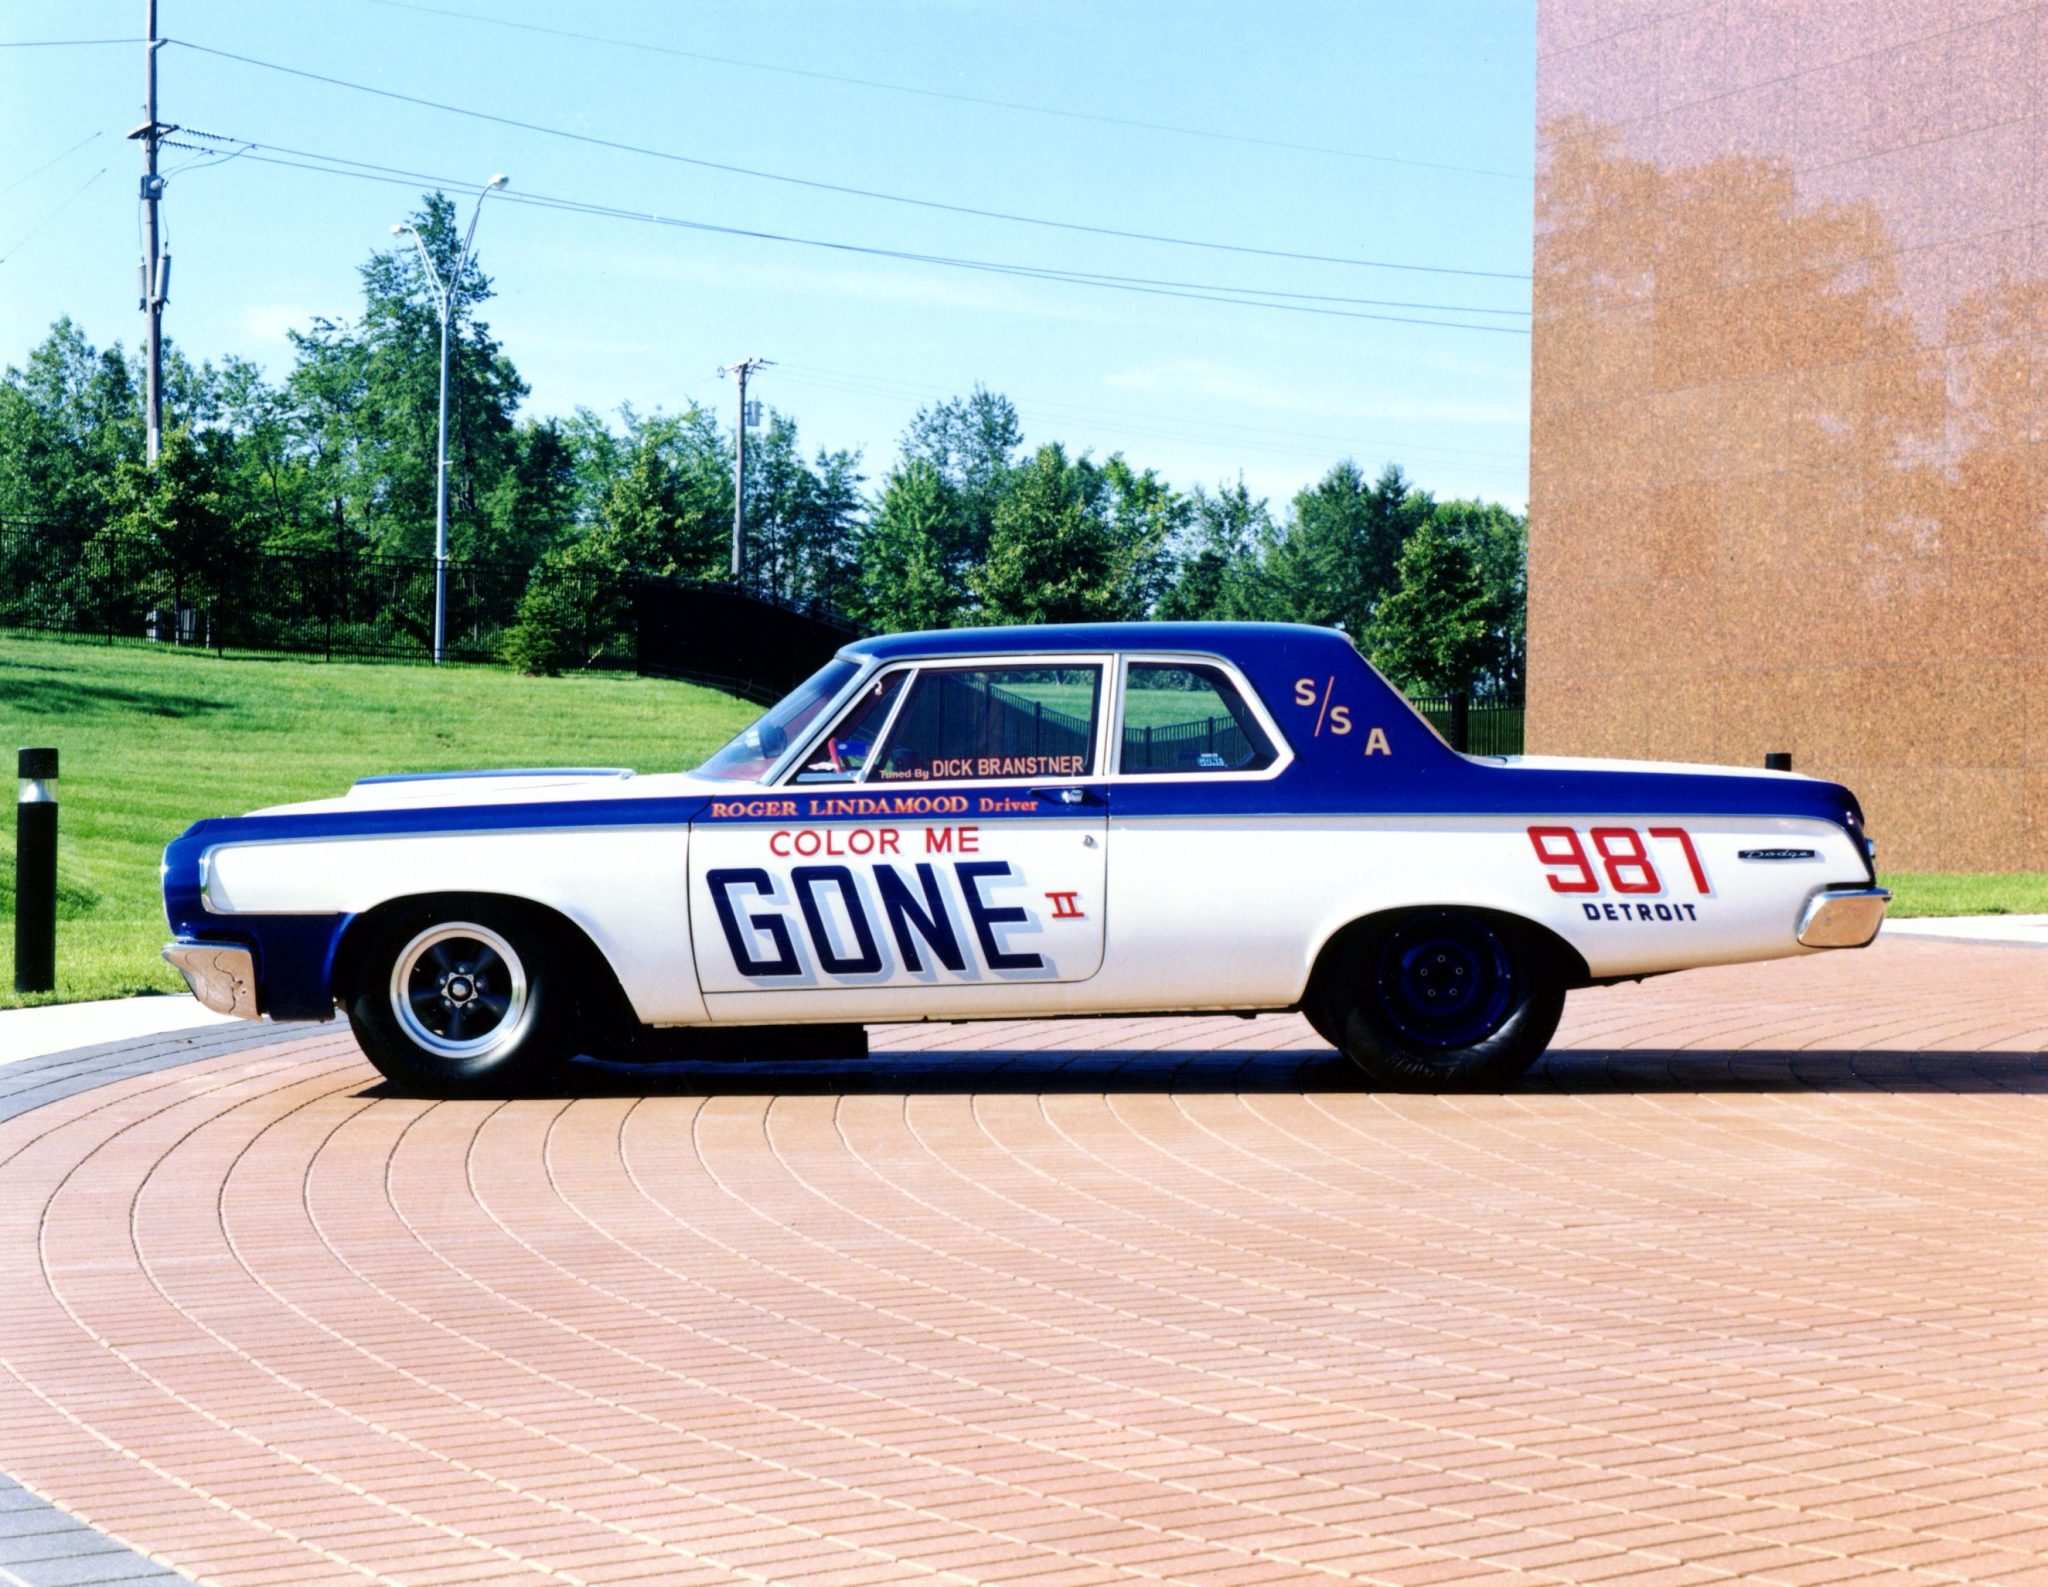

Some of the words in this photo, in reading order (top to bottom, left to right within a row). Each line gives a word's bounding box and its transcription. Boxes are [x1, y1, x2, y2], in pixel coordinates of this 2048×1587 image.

[1364, 727, 1392, 756] A
[879, 768, 912, 780] Tuned
[914, 768, 929, 780] By
[932, 758, 974, 778] DICK
[978, 755, 1085, 777] BRANSTNER
[710, 799, 799, 818] ROGER
[808, 795, 969, 816] LINDAMOOD
[979, 797, 1038, 812] Driver
[769, 827, 901, 857] COLOR
[925, 826, 980, 854] ME
[1743, 848, 1809, 859] Dodge
[1526, 825, 1711, 894] 987
[706, 860, 1048, 978] GONE
[1044, 891, 1085, 919] II
[1582, 902, 1698, 922] DETROIT
